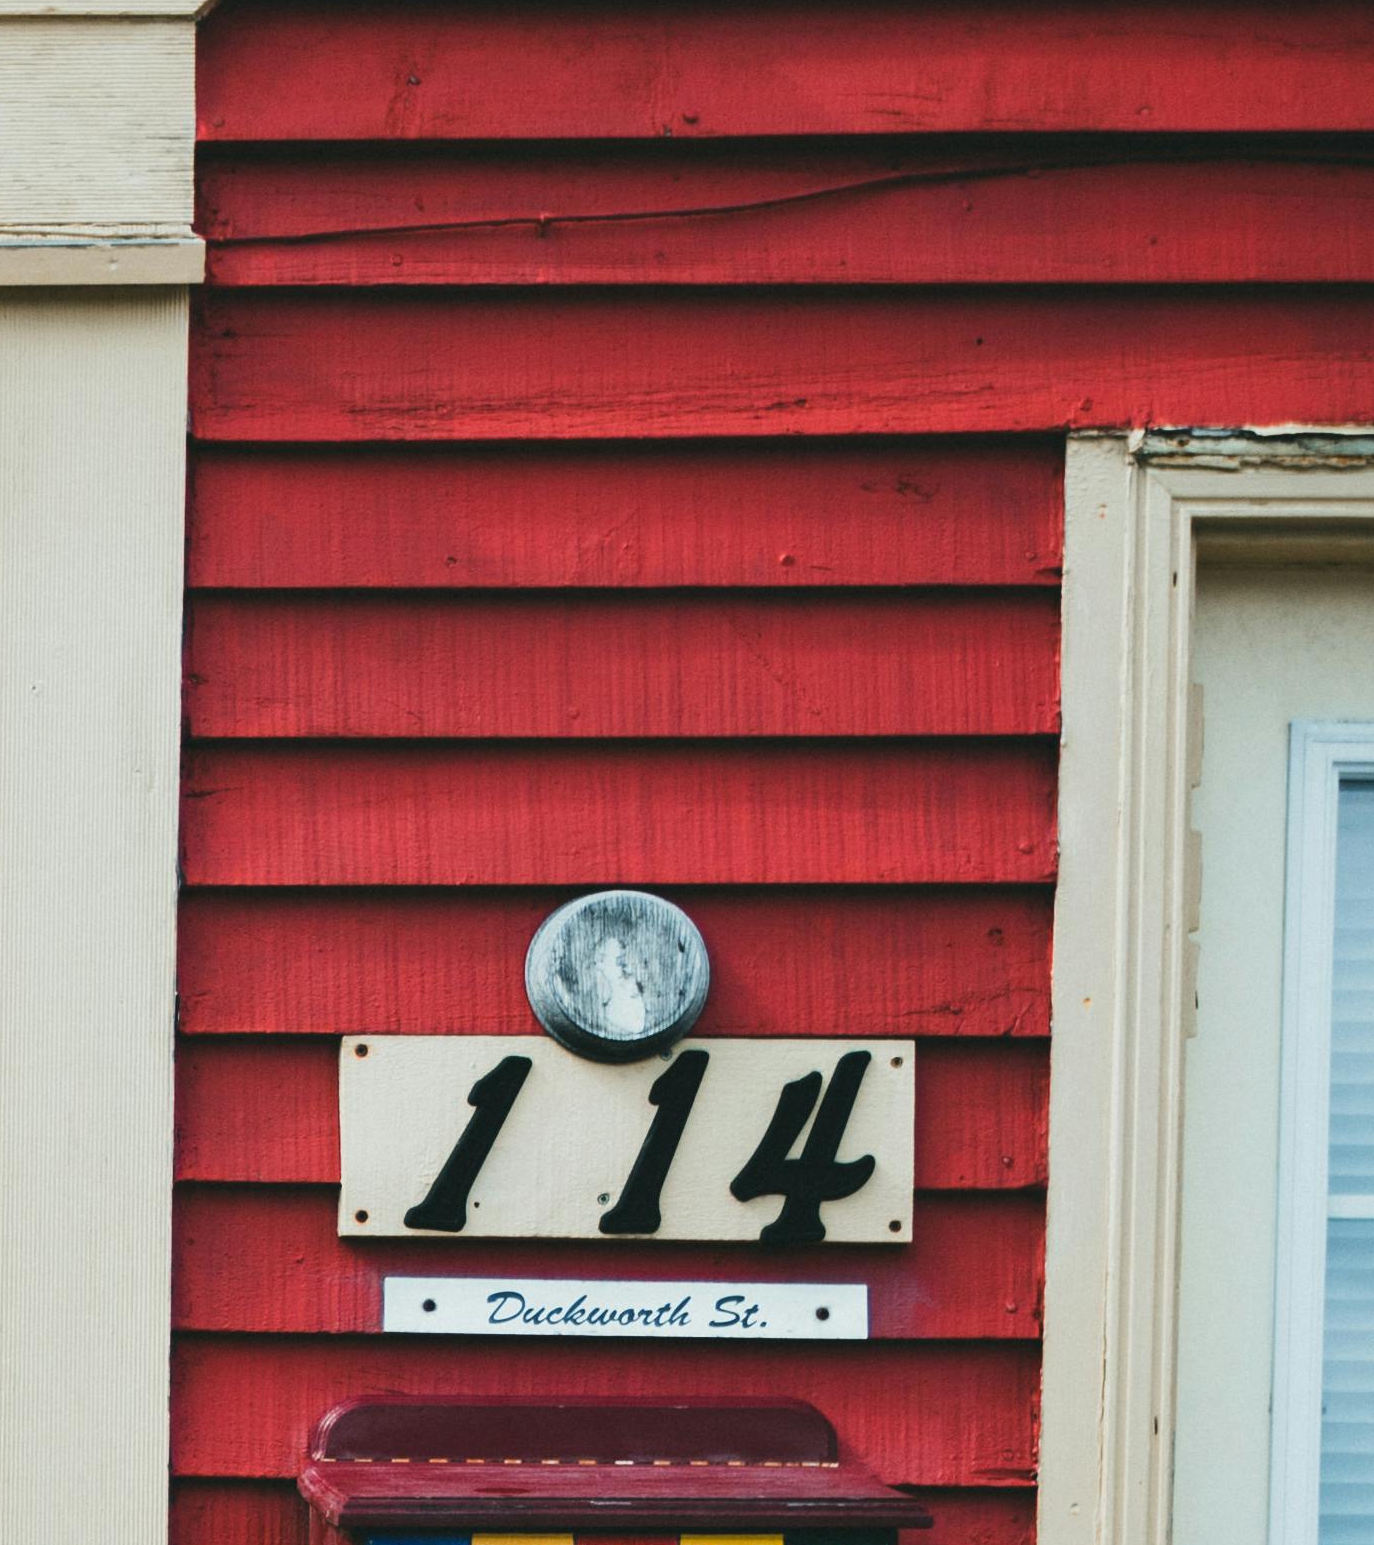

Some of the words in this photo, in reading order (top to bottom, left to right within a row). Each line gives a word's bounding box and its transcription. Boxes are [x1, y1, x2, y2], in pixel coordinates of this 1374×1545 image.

[403, 1050, 876, 1243] 114
[485, 1290, 692, 1328] Duckworth
[708, 1295, 769, 1329] St.
